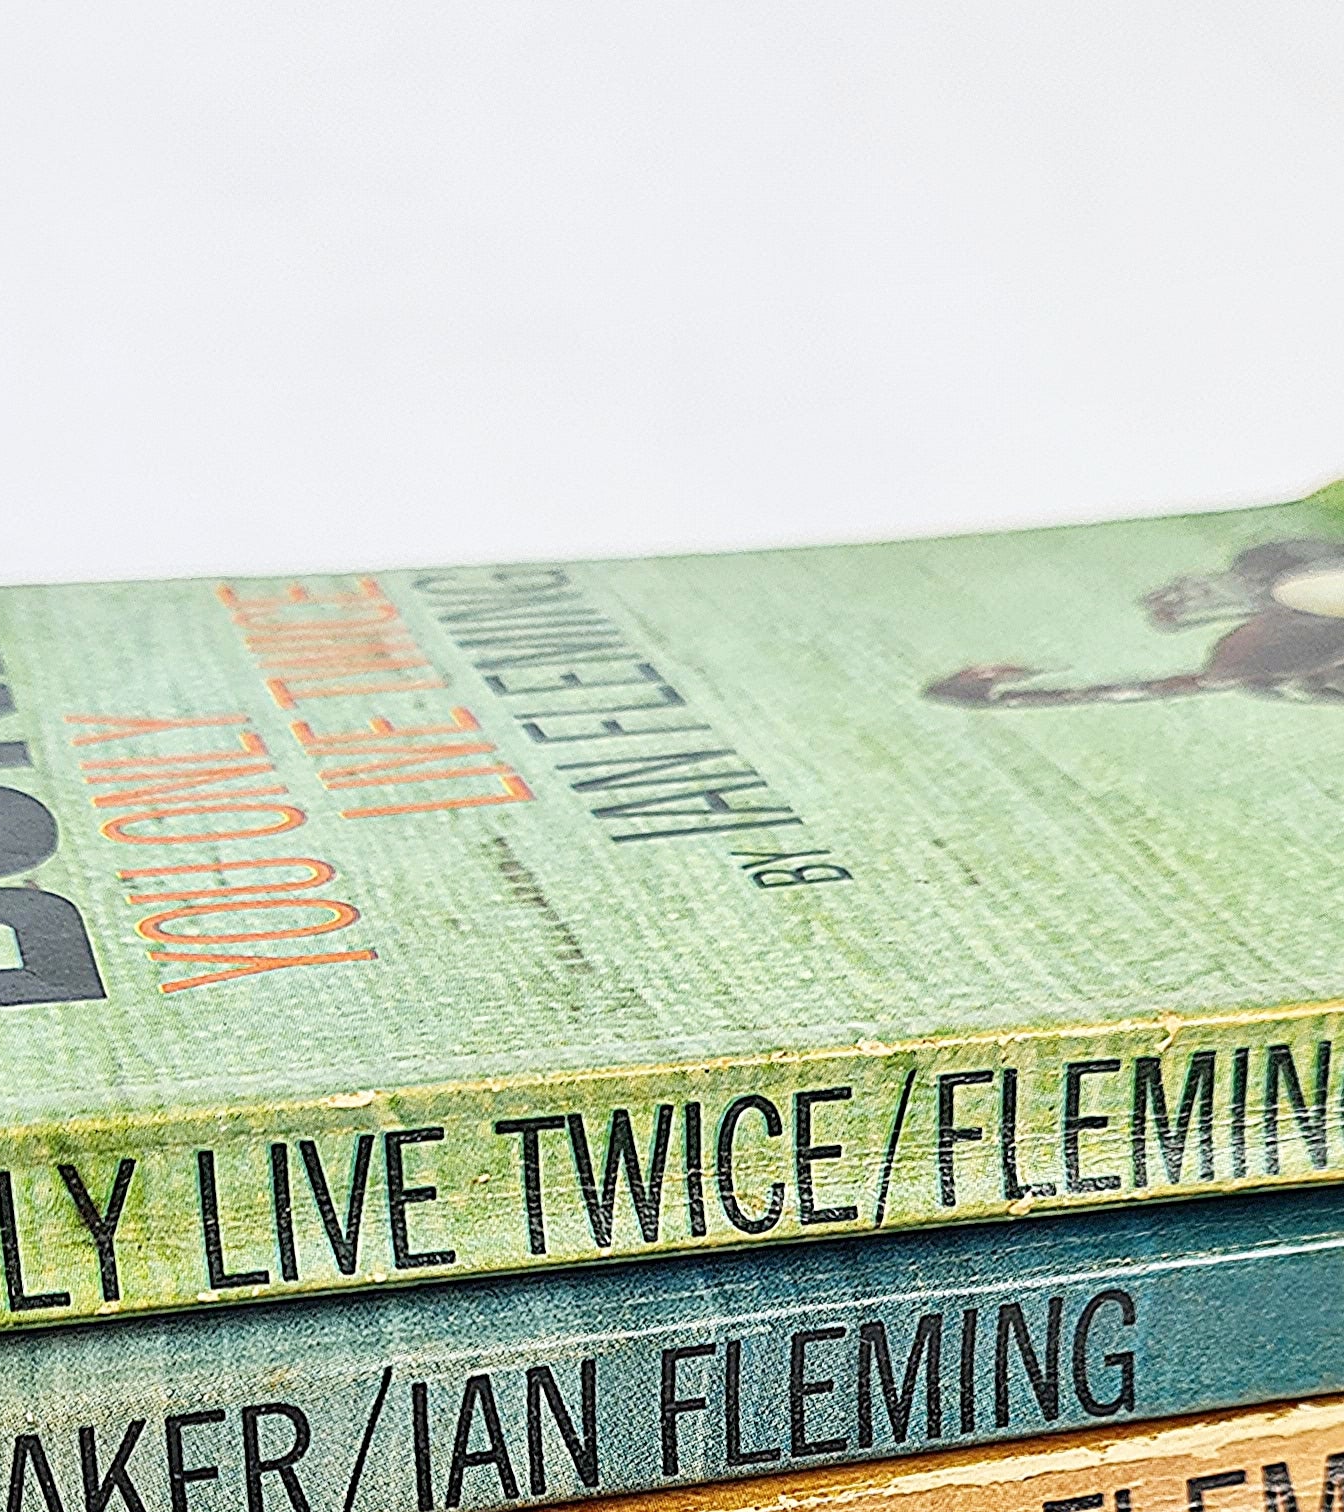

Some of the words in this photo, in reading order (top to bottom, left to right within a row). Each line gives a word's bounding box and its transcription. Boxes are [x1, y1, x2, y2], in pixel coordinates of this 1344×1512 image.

[216, 576, 449, 710] TWICE
[411, 567, 712, 744] FLEMING
[65, 711, 307, 846] ONLY
[290, 705, 535, 820] LIVE
[556, 748, 804, 843] IAN
[118, 856, 378, 993] YOU
[729, 848, 853, 890] BY
[197, 1125, 457, 1291] LIVE
[659, 1289, 1137, 1477] FLEMING
